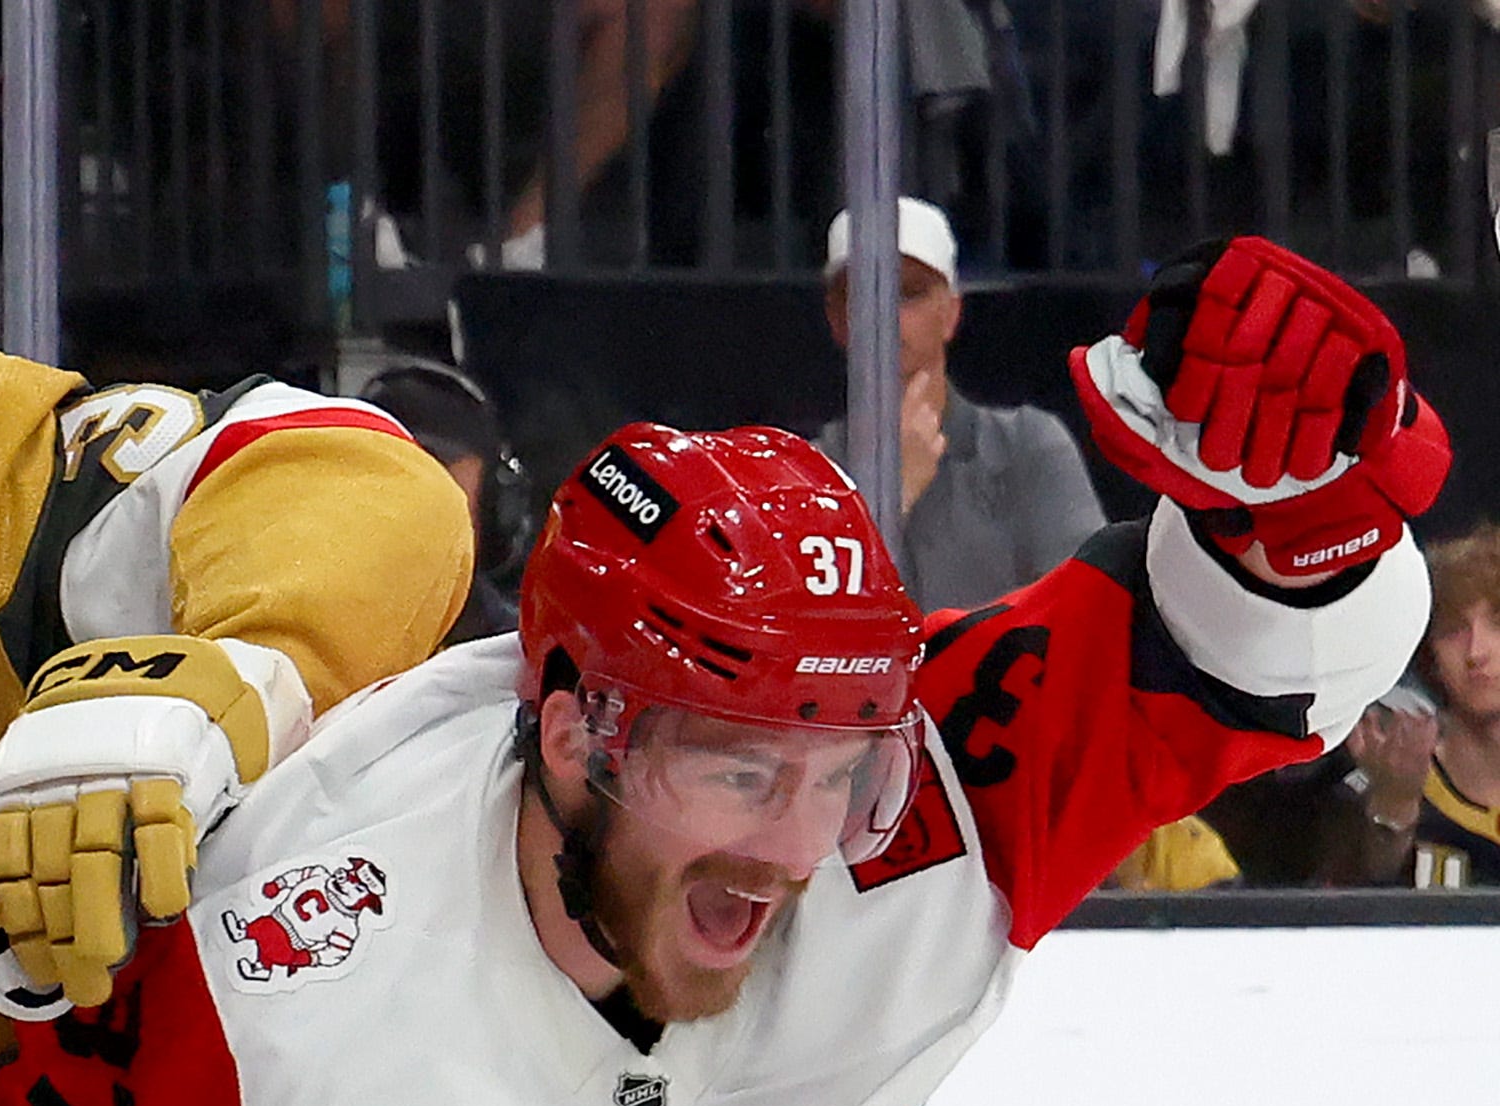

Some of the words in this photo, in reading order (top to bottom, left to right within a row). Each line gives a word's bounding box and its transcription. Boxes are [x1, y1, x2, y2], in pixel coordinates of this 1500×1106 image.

[589, 451, 660, 524] Lenovo
[800, 536, 863, 595] 37
[25, 651, 187, 700] CM
[796, 656, 892, 675] BAUER
